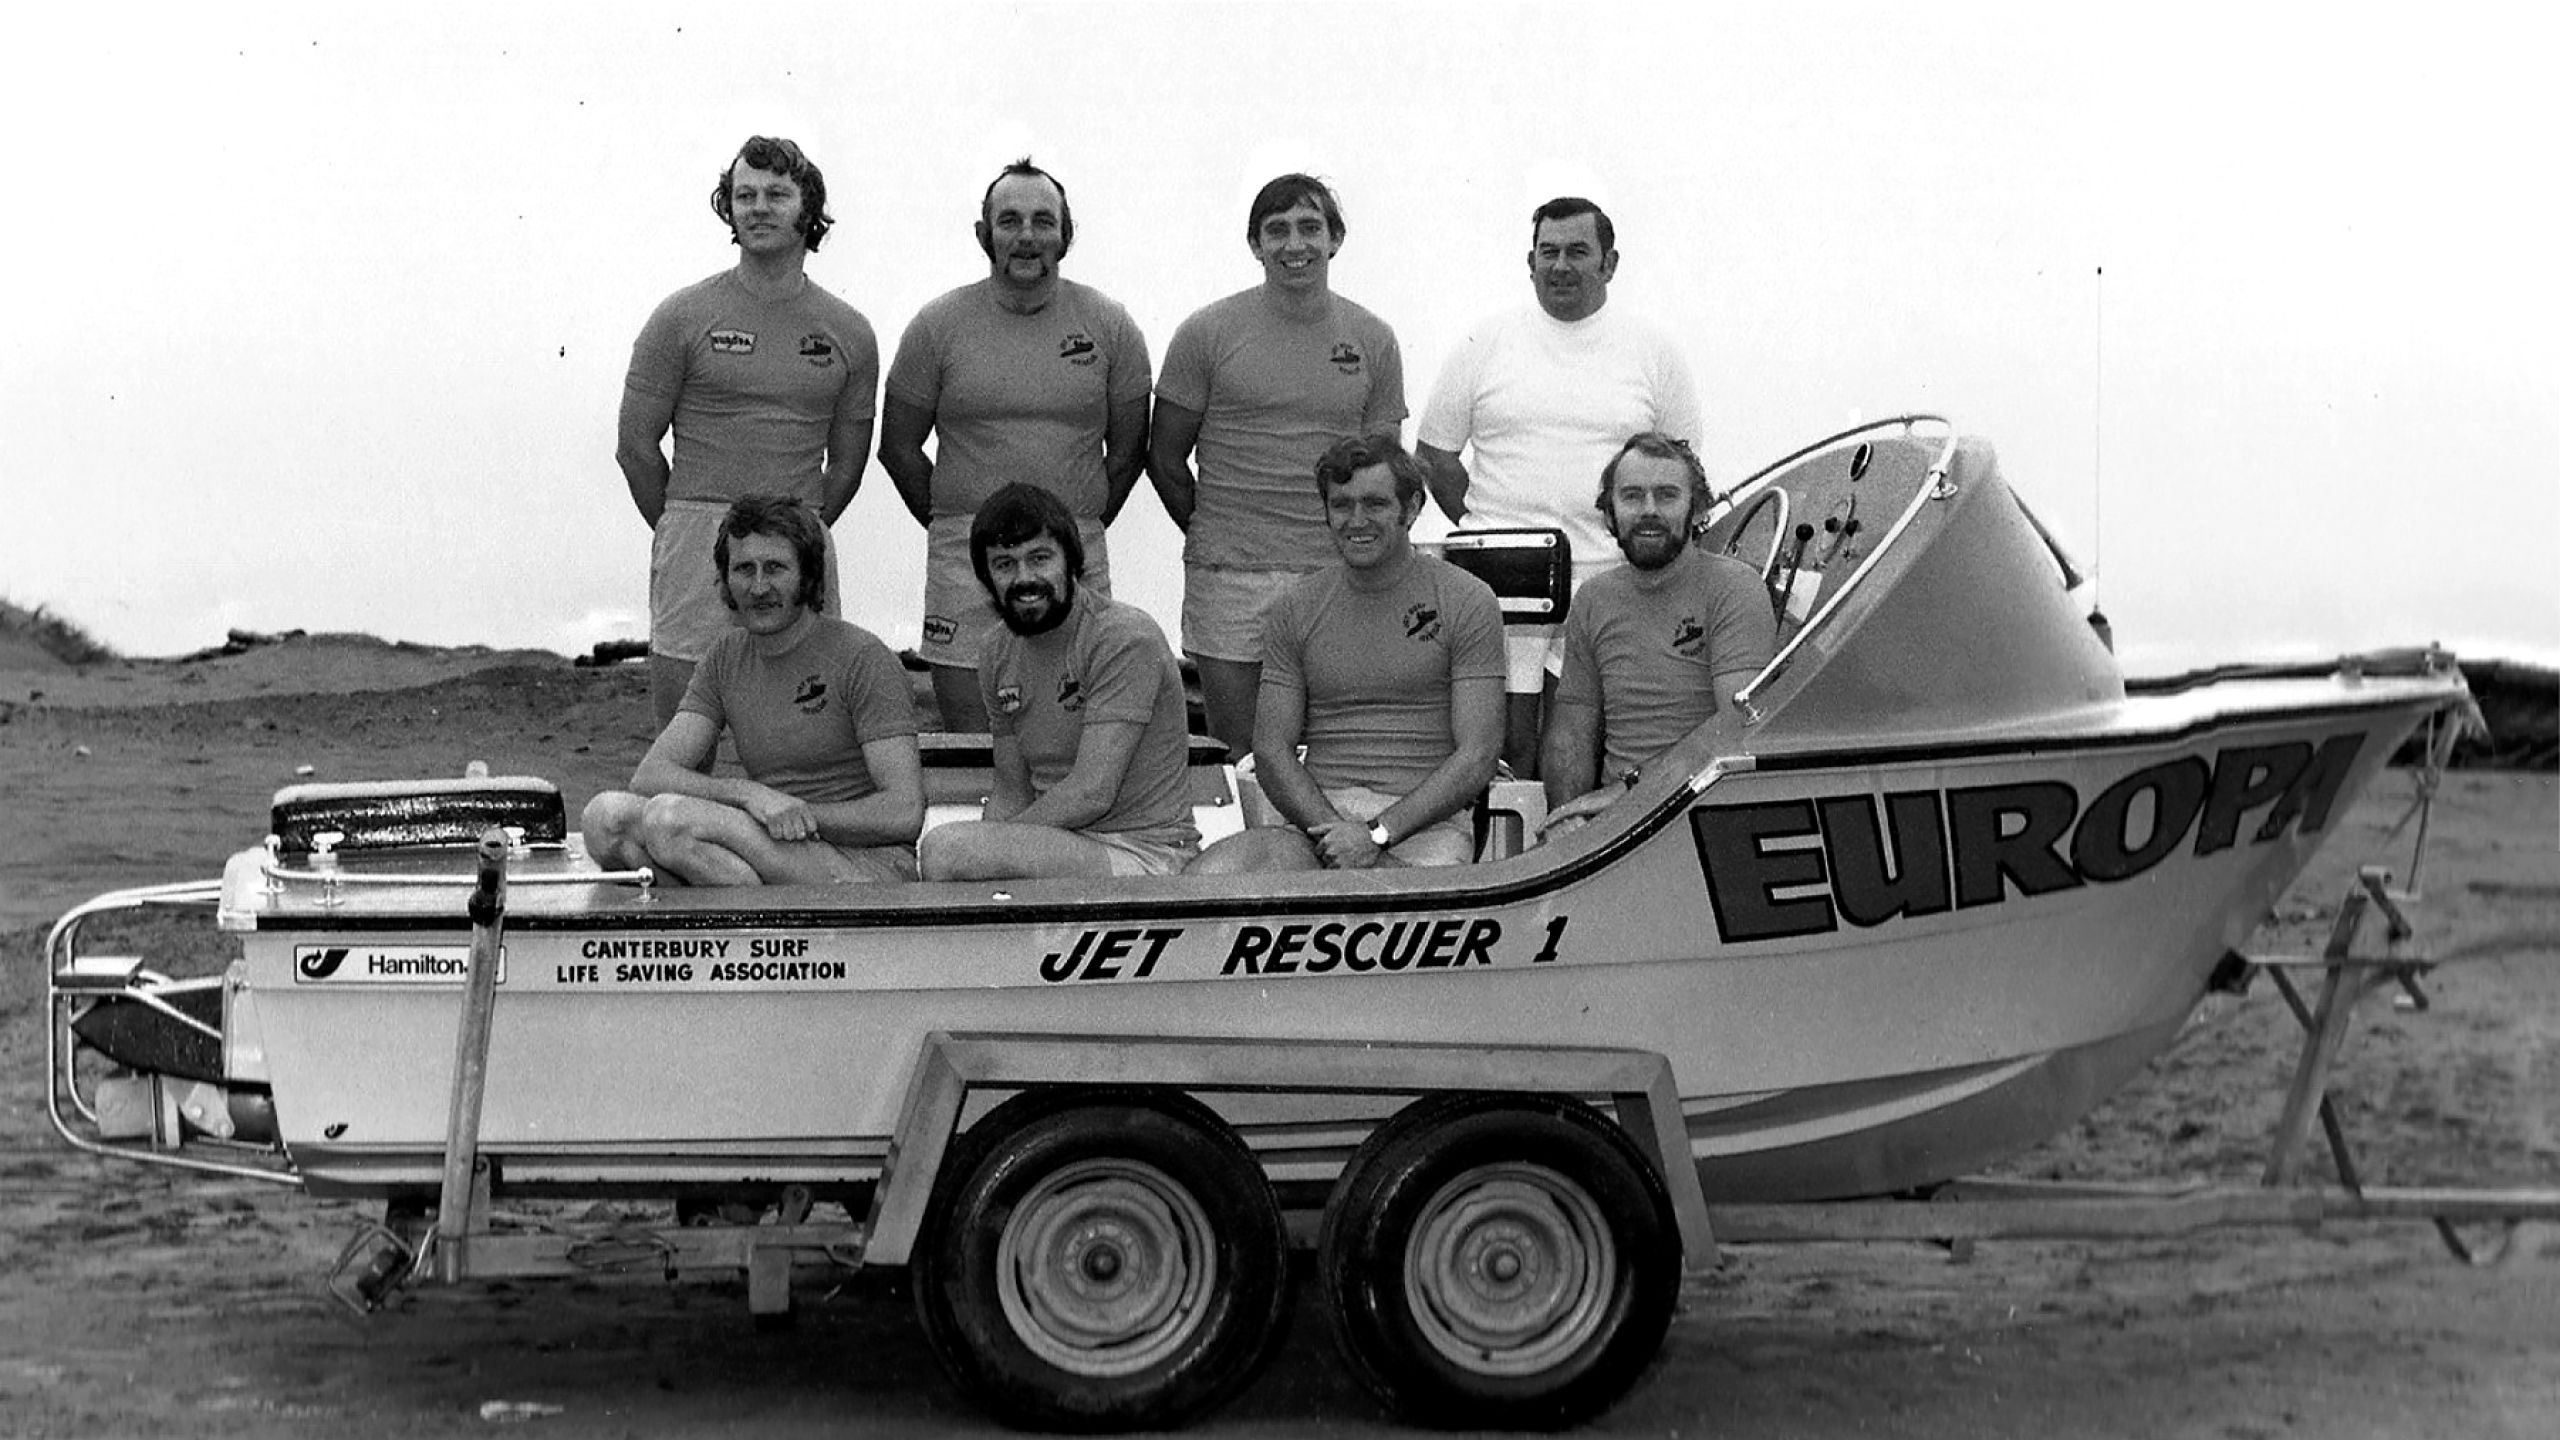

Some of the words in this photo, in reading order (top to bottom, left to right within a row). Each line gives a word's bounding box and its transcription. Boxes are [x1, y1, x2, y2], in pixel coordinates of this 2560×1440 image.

[1688, 731, 2368, 943] EUROPA
[581, 939, 730, 959] CANTERBURY
[750, 939, 810, 958] SURF
[1039, 928, 1185, 983] JET
[1219, 918, 1502, 976] RESCUER
[1533, 915, 1569, 963] 1
[557, 964, 600, 983] LIFE
[616, 963, 694, 982] SAVING
[709, 961, 847, 982] ASSOCIATION
